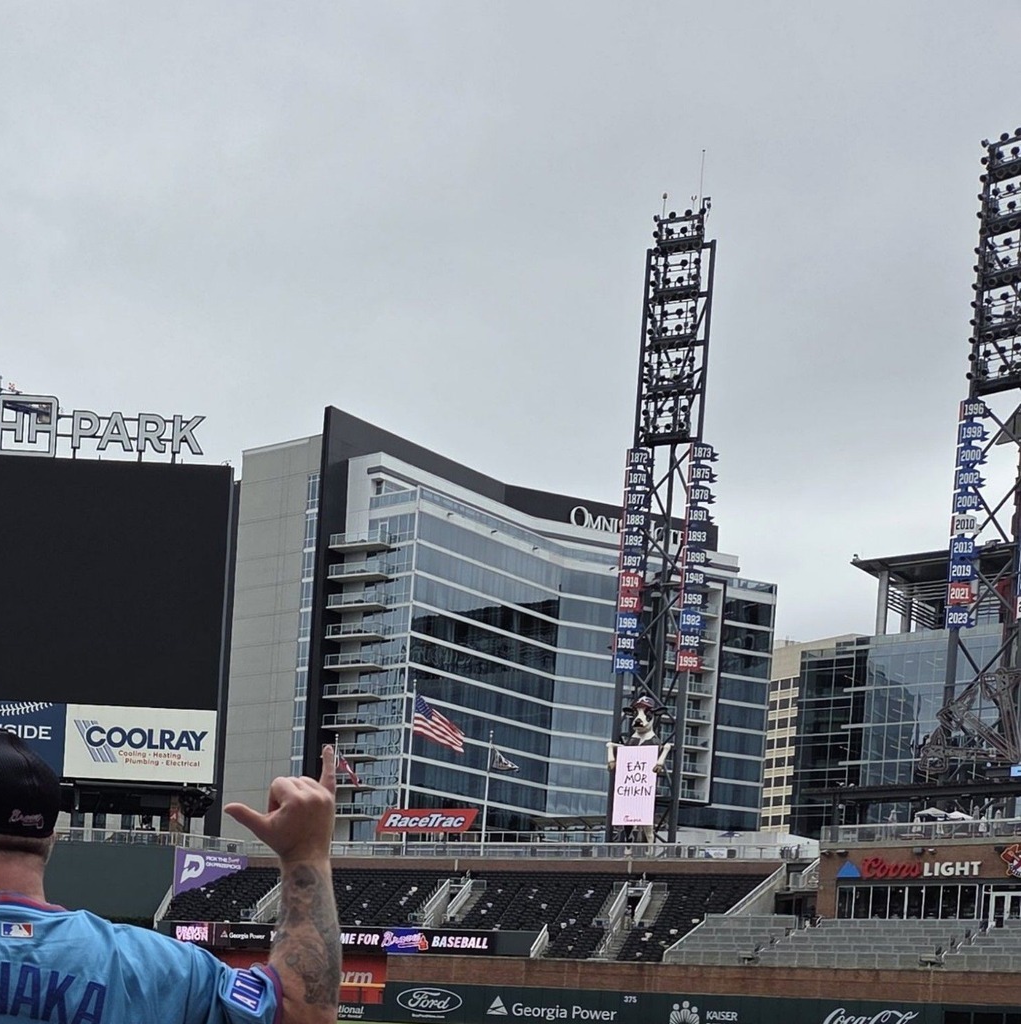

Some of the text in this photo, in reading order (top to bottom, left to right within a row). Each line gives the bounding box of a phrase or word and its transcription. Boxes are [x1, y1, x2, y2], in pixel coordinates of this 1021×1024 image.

[964, 403, 984, 416] 1996
[72, 409, 206, 456] PARK
[962, 426, 982, 438] 1998
[631, 453, 648, 463] 1872
[694, 447, 712, 458] 1873
[960, 449, 981, 462] 2000
[630, 473, 646, 484] 1874
[692, 468, 710, 478] 1875
[959, 472, 979, 484] 2002
[628, 494, 645, 504] 1877
[691, 489, 710, 500] 1878
[957, 496, 978, 507] 2004
[626, 514, 644, 525] 1883
[690, 510, 708, 520] 1891
[956, 519, 974, 530] 2010
[625, 535, 643, 546] 1892
[688, 531, 707, 542] 1893
[954, 542, 973, 553] 2013
[624, 556, 641, 566] 1897
[687, 552, 706, 562] 1898
[952, 565, 971, 576] 2019
[622, 576, 638, 587] 1914
[684, 593, 702, 605] 1958
[950, 588, 969, 599] 2021
[620, 597, 638, 608] 1957
[619, 618, 637, 628] 1969
[682, 614, 701, 626] 1982
[948, 612, 968, 624] 2023
[618, 638, 634, 649] 1991
[680, 635, 699, 646] 1992
[616, 658, 634, 669] 1993
[679, 656, 698, 666] 1995
[86, 726, 208, 751] COOLRAY
[118, 750, 182, 760] Cooling Heating
[125, 758, 160, 766] Plumbing
[627, 761, 647, 772] EAT
[624, 773, 648, 784] MOR
[617, 786, 652, 796] CHIKIN
[384, 814, 465, 828] RaceTrac
[861, 857, 982, 880] Coors LIGHT
[176, 926, 208, 934] BRAVES
[176, 932, 208, 942] VISION
[229, 932, 248, 940] Georgia
[340, 933, 356, 944] ME
[357, 933, 379, 945] FOR
[432, 936, 488, 949] BASEBALL
[408, 990, 451, 1009] Ford
[338, 1004, 364, 1014] tional
[512, 1003, 617, 1020] Georgia Power
[706, 1011, 738, 1022] KAISER
